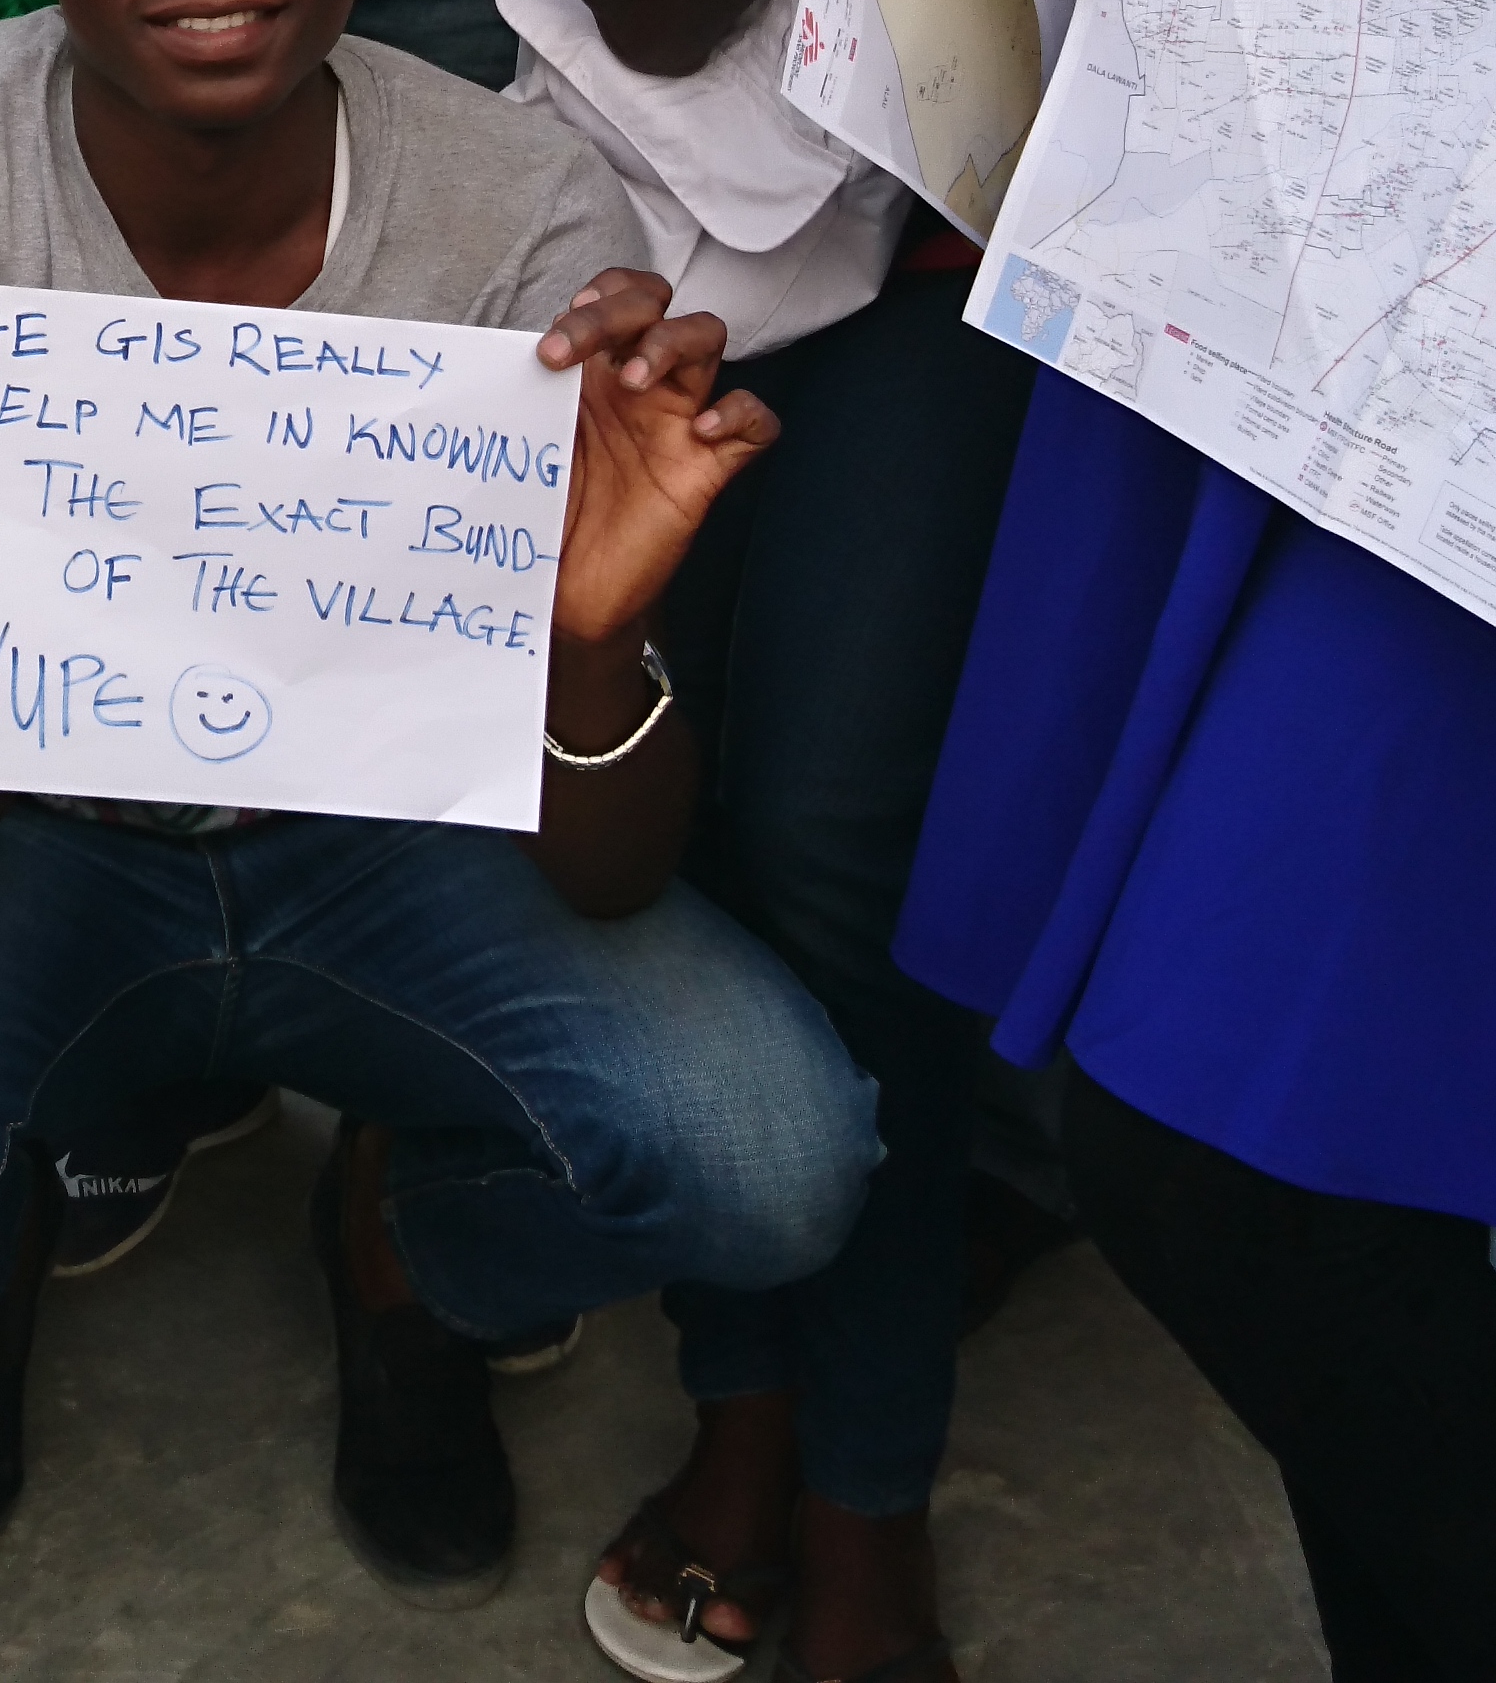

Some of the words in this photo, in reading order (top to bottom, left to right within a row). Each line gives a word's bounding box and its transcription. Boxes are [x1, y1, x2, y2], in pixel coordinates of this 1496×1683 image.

[1087, 63, 1106, 78] DALA
[1108, 69, 1138, 91] LAWANTI
[95, 318, 202, 365] GIS
[228, 322, 445, 390] REALLY
[1191, 338, 1208, 354] Food
[1208, 348, 1230, 367] selling
[1229, 359, 1248, 375] place
[135, 402, 234, 445] ME
[266, 408, 313, 449] IN
[345, 412, 565, 490] KNOWING
[1375, 437, 1398, 455] Road
[1377, 465, 1412, 487] Secondary
[1382, 455, 1408, 473] Primary
[1370, 485, 1397, 503] Railway
[1374, 475, 1394, 489] Other
[23, 459, 143, 520] THE
[194, 483, 392, 540] EXACT
[63, 549, 141, 601] OF
[172, 552, 278, 614] THE
[306, 578, 538, 658] VILLAGE.
